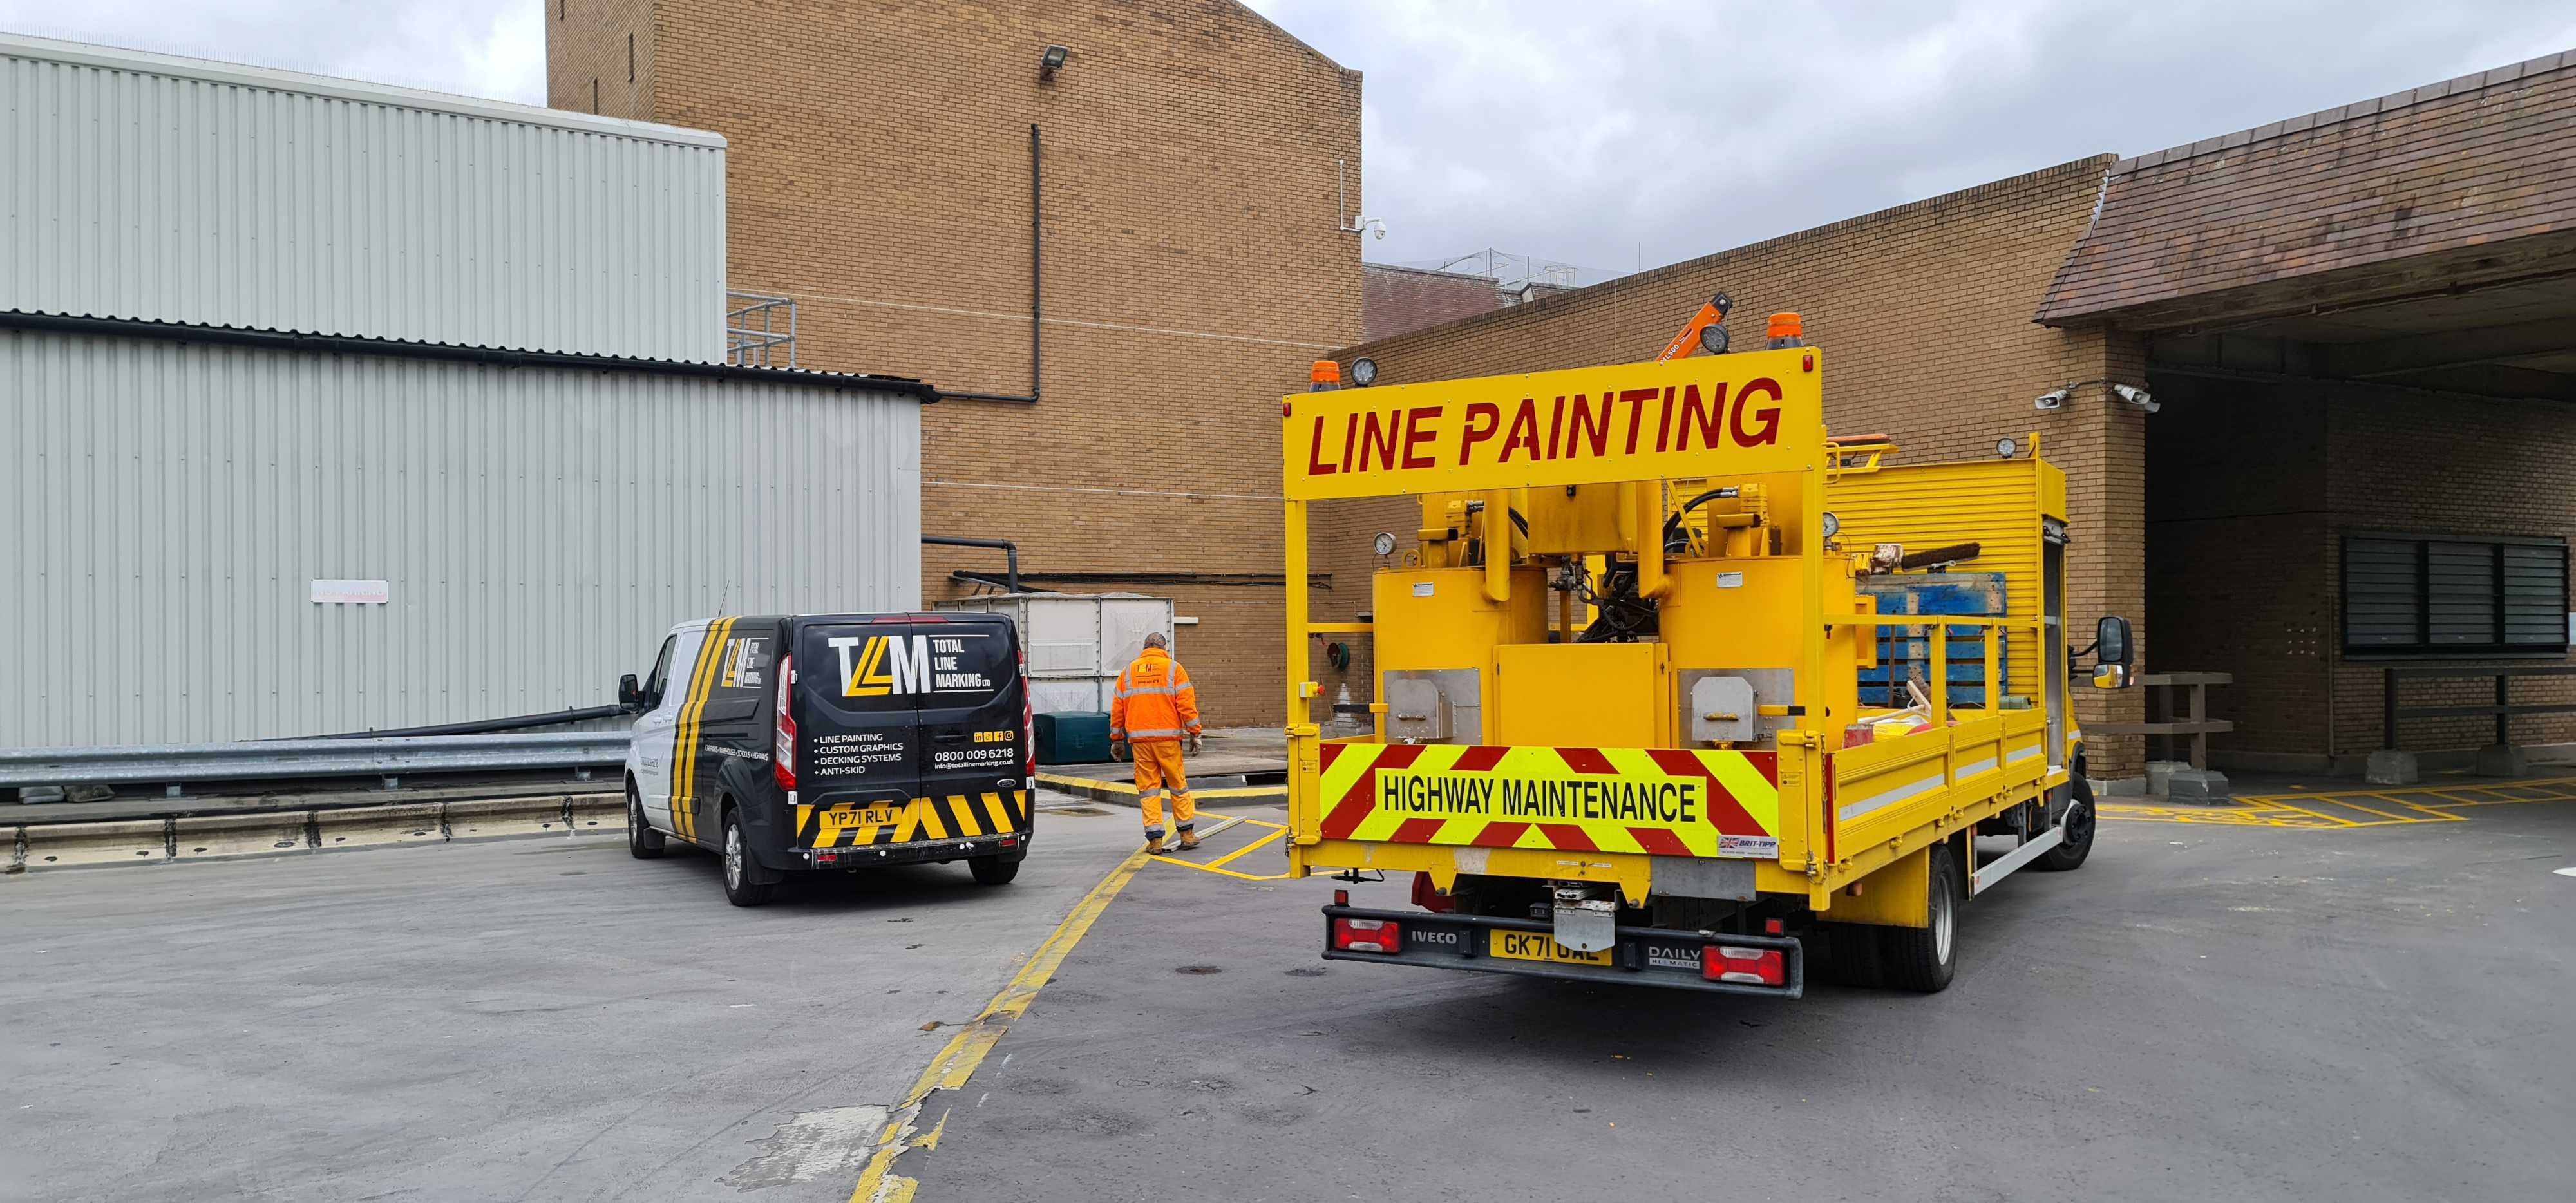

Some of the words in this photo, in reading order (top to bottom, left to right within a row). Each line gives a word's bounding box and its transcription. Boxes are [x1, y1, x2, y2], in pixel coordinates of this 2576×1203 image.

[1309, 406, 1443, 475] LINE
[1459, 377, 1782, 466] PAINTING
[933, 639, 965, 653] TOTAL
[934, 657, 958, 670] LINE
[936, 673, 981, 688] MARKING
[820, 735, 840, 744] LINE
[842, 734, 883, 743] PAINTING
[820, 746, 858, 754] CUSTOM
[860, 743, 904, 752] GRAPHICS
[934, 752, 964, 761] 0800
[966, 750, 987, 760] 009
[989, 748, 1014, 758] 6218
[820, 756, 860, 764] DECKING
[862, 753, 902, 763] SYSTEMS
[934, 759, 1014, 770] info@totallinemarking.co.uk
[820, 766, 866, 775] ANTI-SKID
[1384, 775, 1494, 814] HIGHWAY
[1502, 779, 1696, 822] MAINTENANCE
[829, 811, 861, 826] YP71
[866, 809, 893, 824] RLV
[1412, 931, 1457, 944] IVECO
[1505, 934, 1550, 957] GK71
[1649, 946, 1700, 960] DAILY
